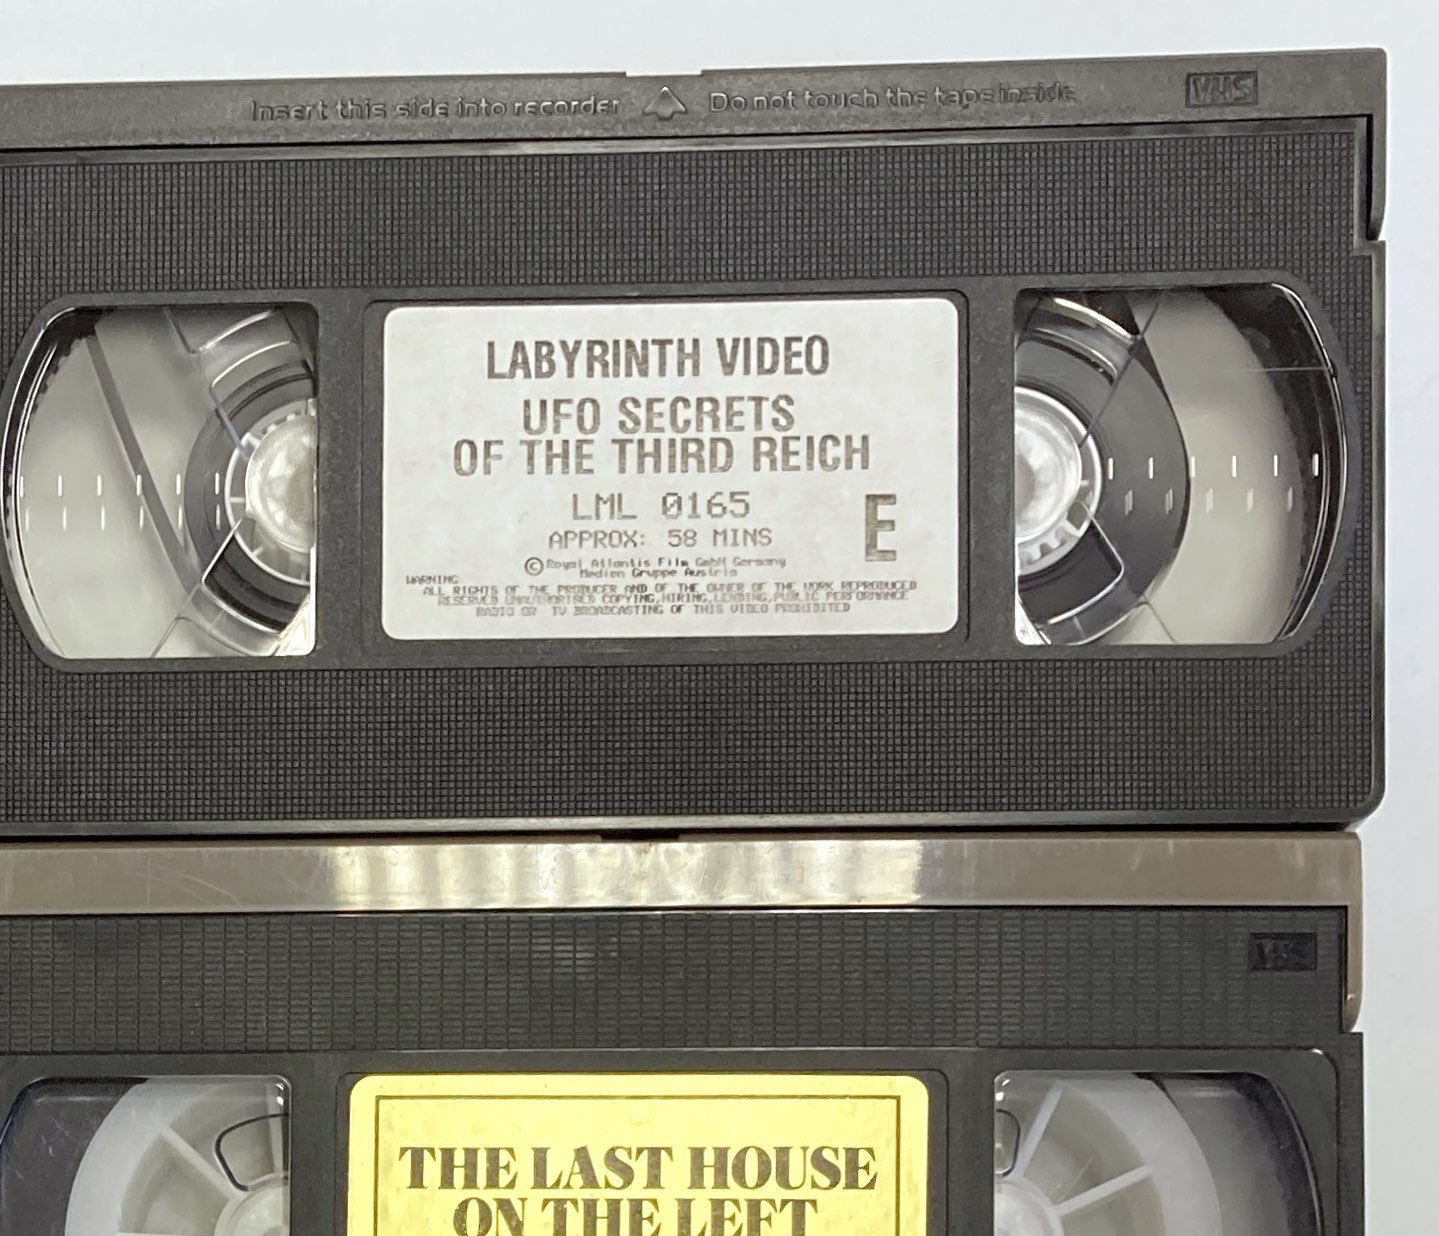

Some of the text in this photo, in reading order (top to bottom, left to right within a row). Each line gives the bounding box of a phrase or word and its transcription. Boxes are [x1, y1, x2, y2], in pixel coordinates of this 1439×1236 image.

[488, 335, 829, 379] LABYRINTH VIDEO
[523, 394, 795, 435] UFO SECRETS
[454, 434, 869, 476] OF THE THIRD REICH
[573, 491, 750, 520] LML 0165
[549, 528, 772, 549] APPROX: 58 MINS
[865, 494, 898, 562] E
[399, 1146, 878, 1190] THE LAST HOUSE
